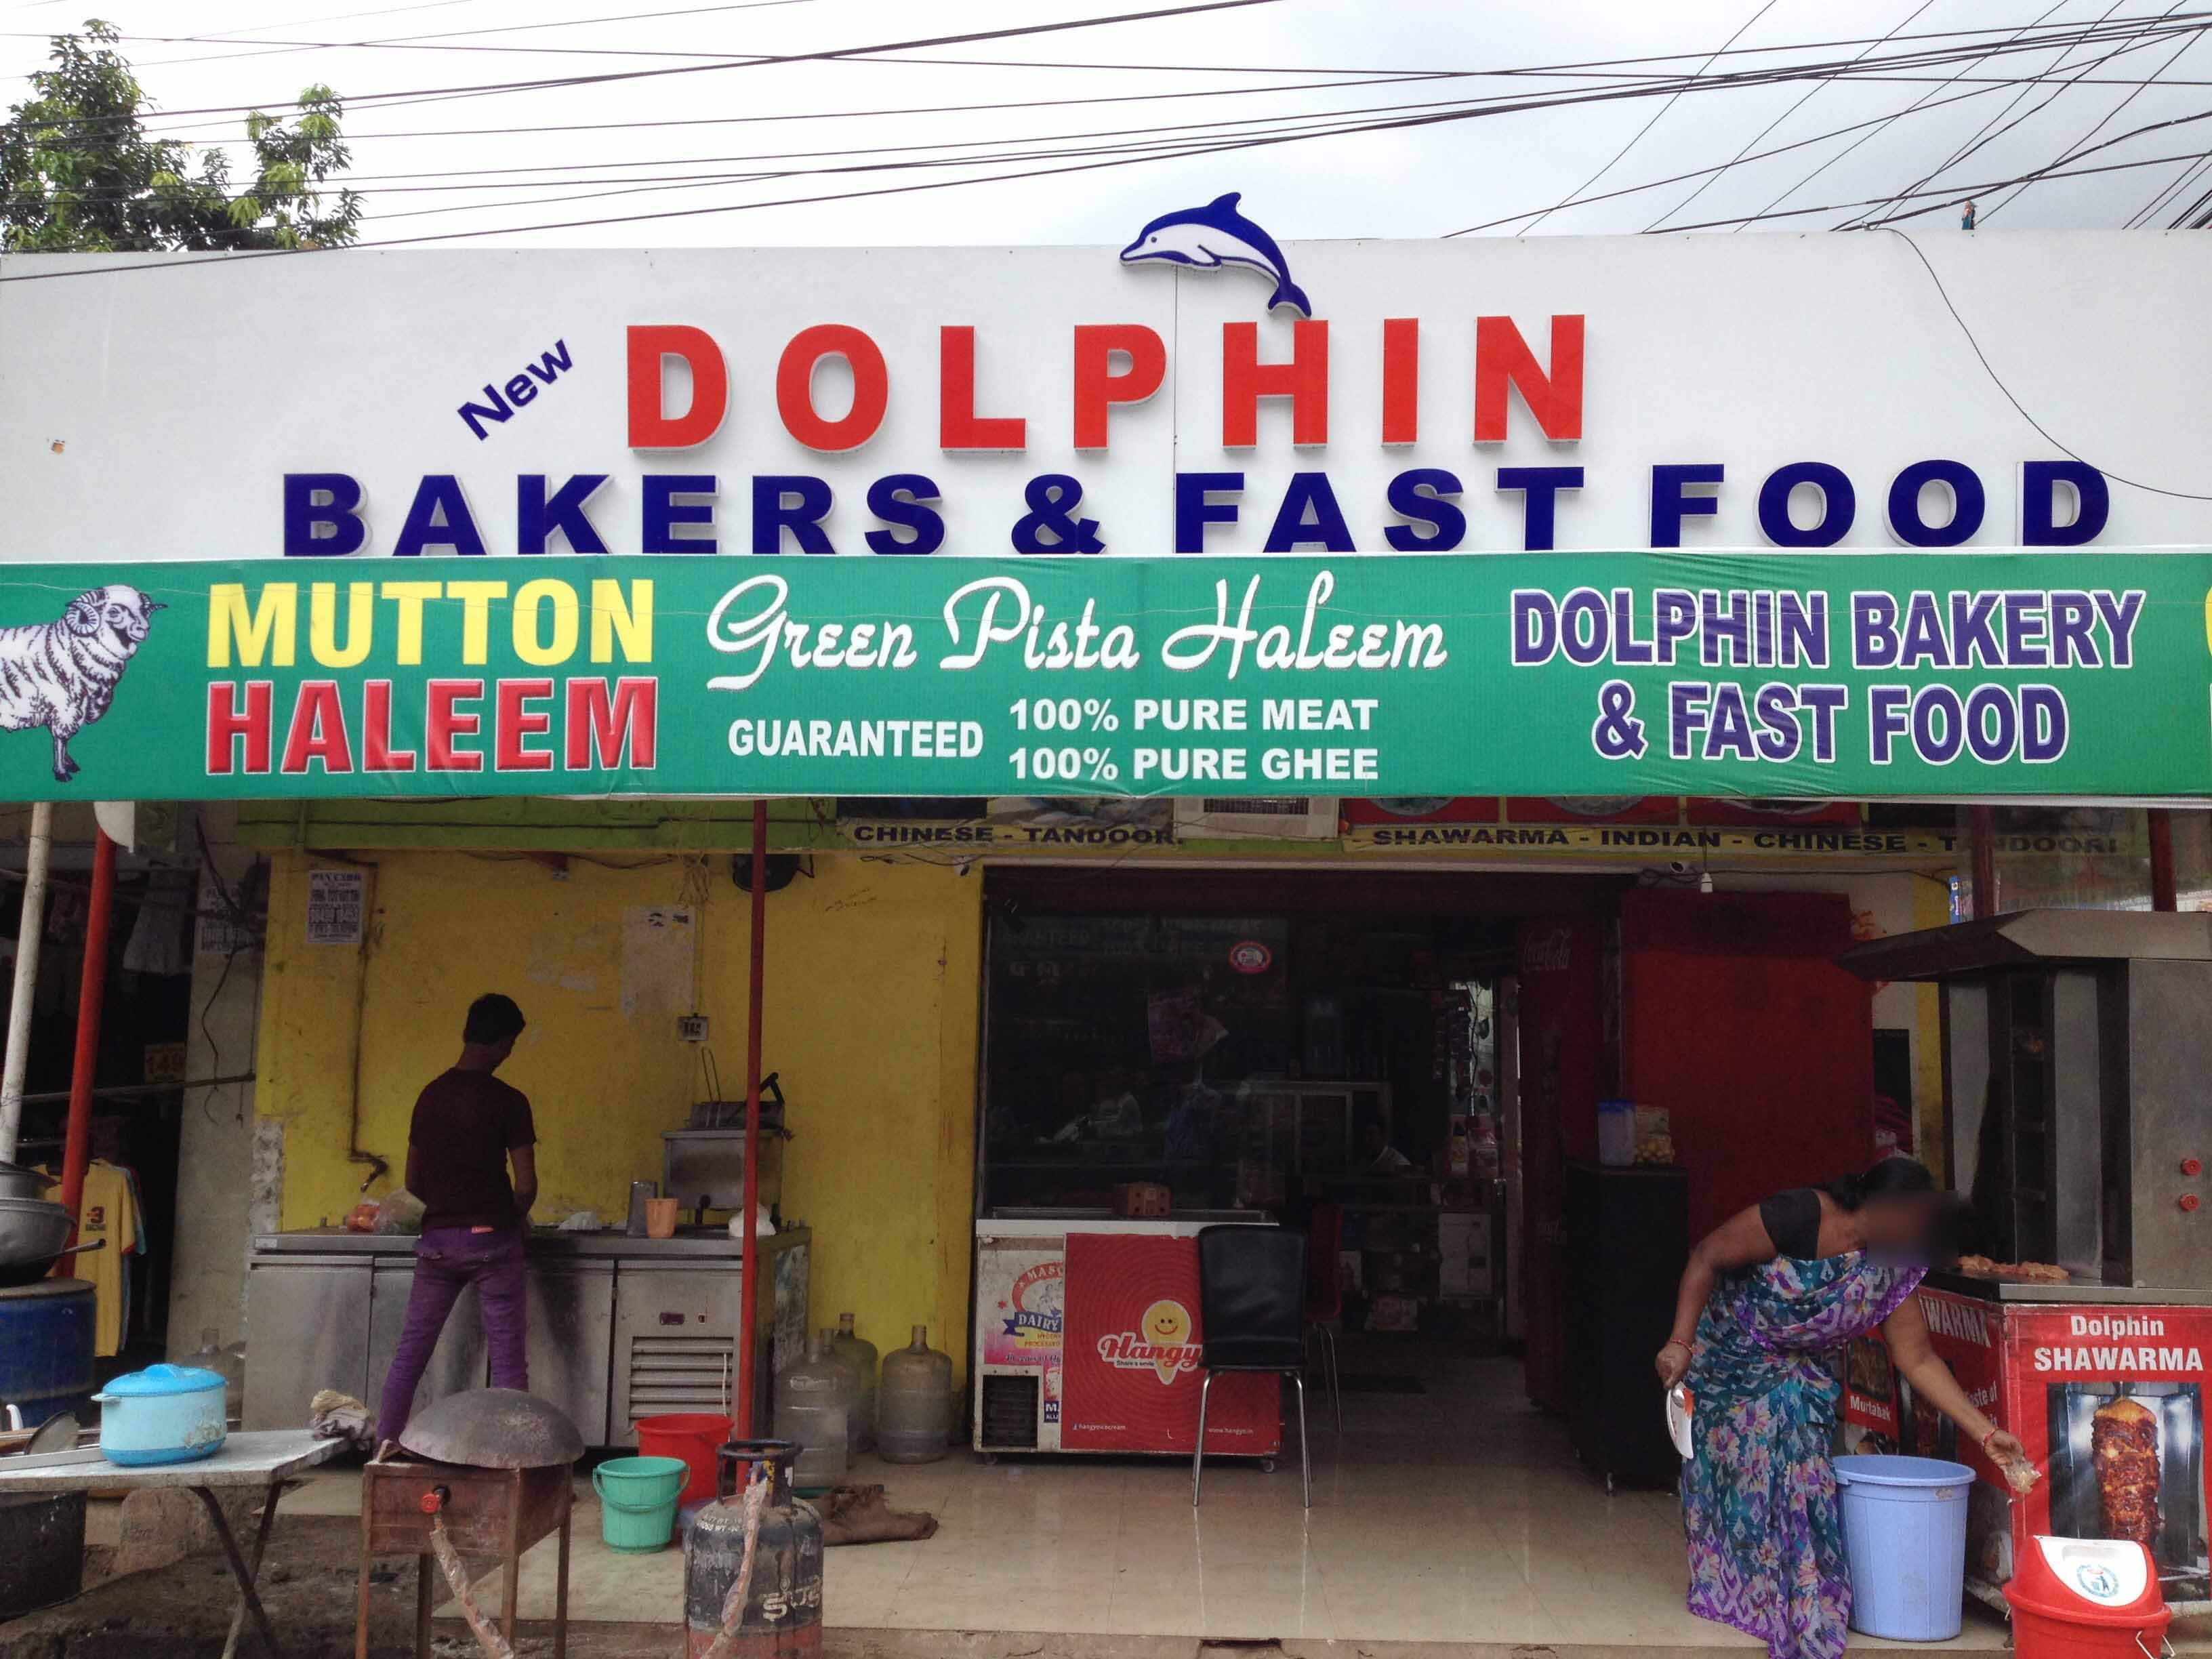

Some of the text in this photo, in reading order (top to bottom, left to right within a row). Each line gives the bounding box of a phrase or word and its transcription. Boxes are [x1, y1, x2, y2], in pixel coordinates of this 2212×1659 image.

[457, 338, 573, 441] New
[626, 314, 1586, 453] DOLPHIN
[283, 459, 2110, 556] BAKERS & FAST FOOD
[206, 578, 655, 668] MUTTON
[706, 570, 1448, 691] Green Pista Haleem
[1510, 587, 1830, 670] DOLPHIN
[1849, 589, 2147, 670] BAKERY
[205, 676, 657, 775] HALEEM
[1008, 698, 1379, 732] 100% PURE MEAT
[1591, 680, 2070, 766] & FAST FOOD
[728, 718, 985, 758] GUARANTEED
[1008, 747, 1379, 781] 100% PURE GHEE
[854, 824, 994, 843] CHINESE
[1023, 826, 1183, 846] TANDOOR
[1372, 828, 1570, 847] SHAWARMA
[1599, 829, 1722, 848] INDIAN
[1752, 831, 1908, 853] CHINESE
[1938, 834, 2118, 855] TDOORI
[1019, 1314, 1059, 1331] DAIRY
[2070, 1315, 2165, 1340] Dolphin
[2034, 1346, 2205, 1372] SHAWARMA
[1849, 1395, 1891, 1422] Murtabak
